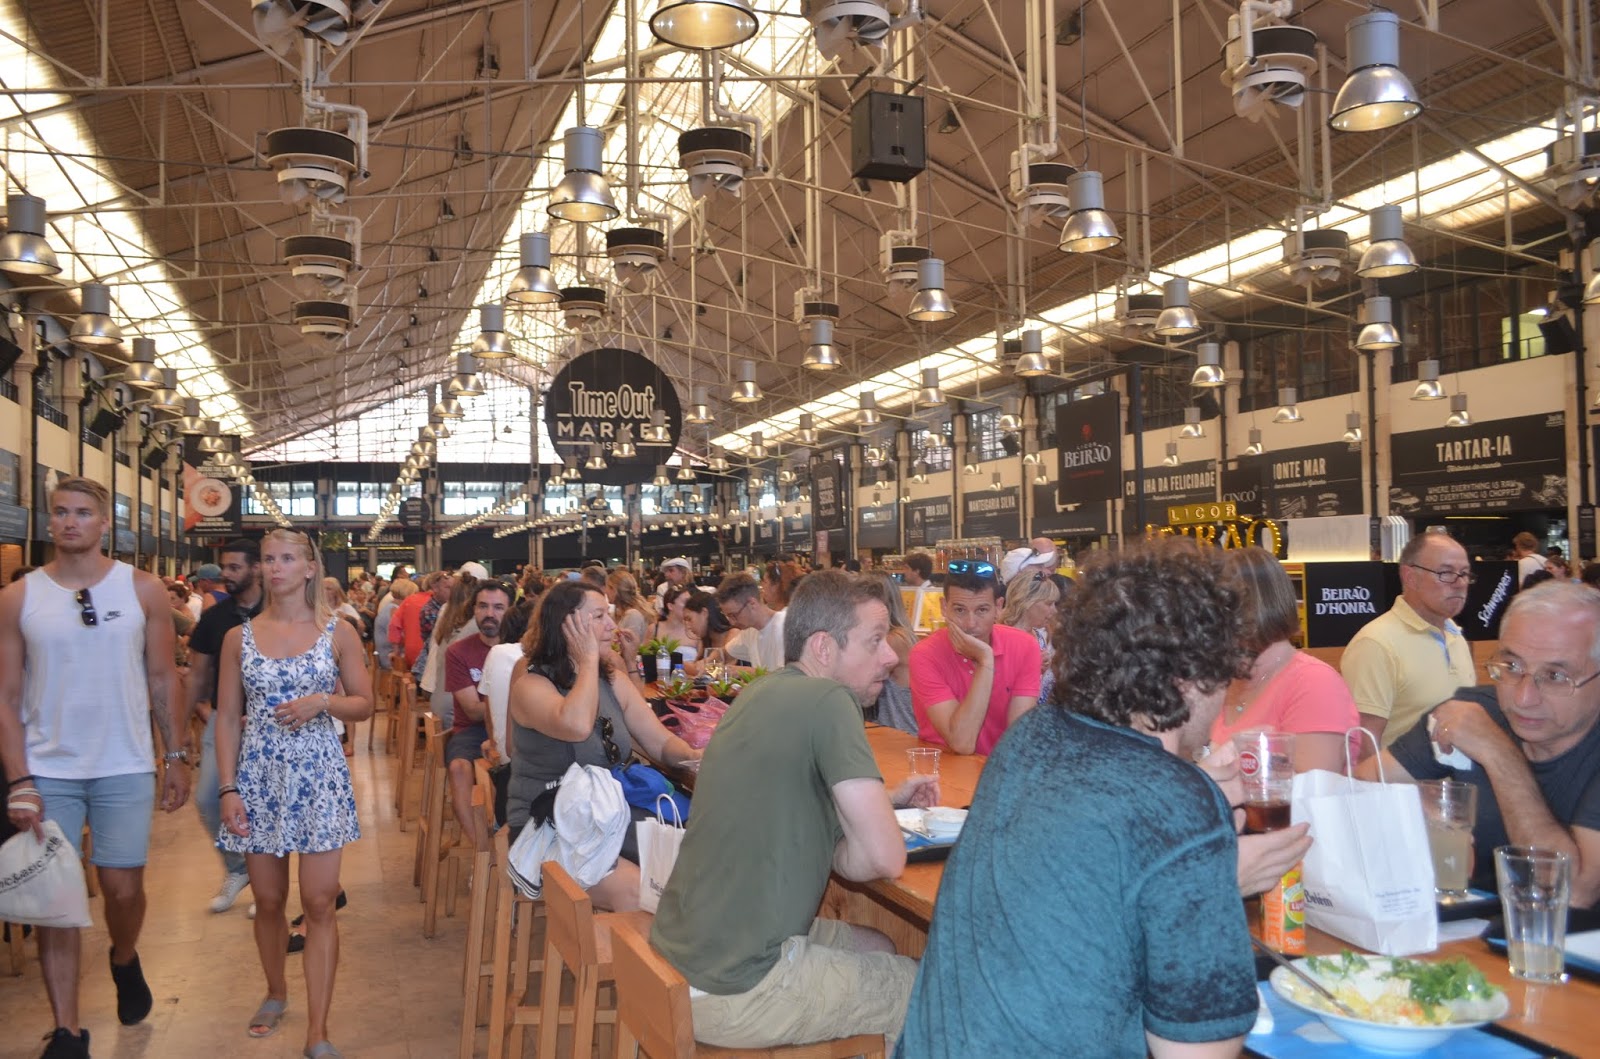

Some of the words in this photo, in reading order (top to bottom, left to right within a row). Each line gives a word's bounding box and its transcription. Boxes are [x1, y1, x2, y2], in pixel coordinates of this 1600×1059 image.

[568, 381, 618, 419] Time
[617, 384, 655, 419] Out
[557, 421, 671, 439] MARKE
[1064, 444, 1111, 468] BEIRÃO
[1436, 435, 1512, 462] TARTAR-IA
[1273, 461, 1301, 480] ONTE
[1303, 458, 1326, 476] MAR
[1125, 478, 1157, 496] CONHA
[1170, 471, 1215, 491] FELICIDADE
[1450, 482, 1490, 492] EVERYTHING
[1223, 490, 1256, 502] CINCO
[1439, 491, 1479, 501] EVERYTHING
[1171, 503, 1237, 521] LICOR
[1321, 586, 1370, 601] BEIRÃO
[1478, 570, 1512, 628] Schweppes
[1315, 601, 1376, 615] D'HONRA
